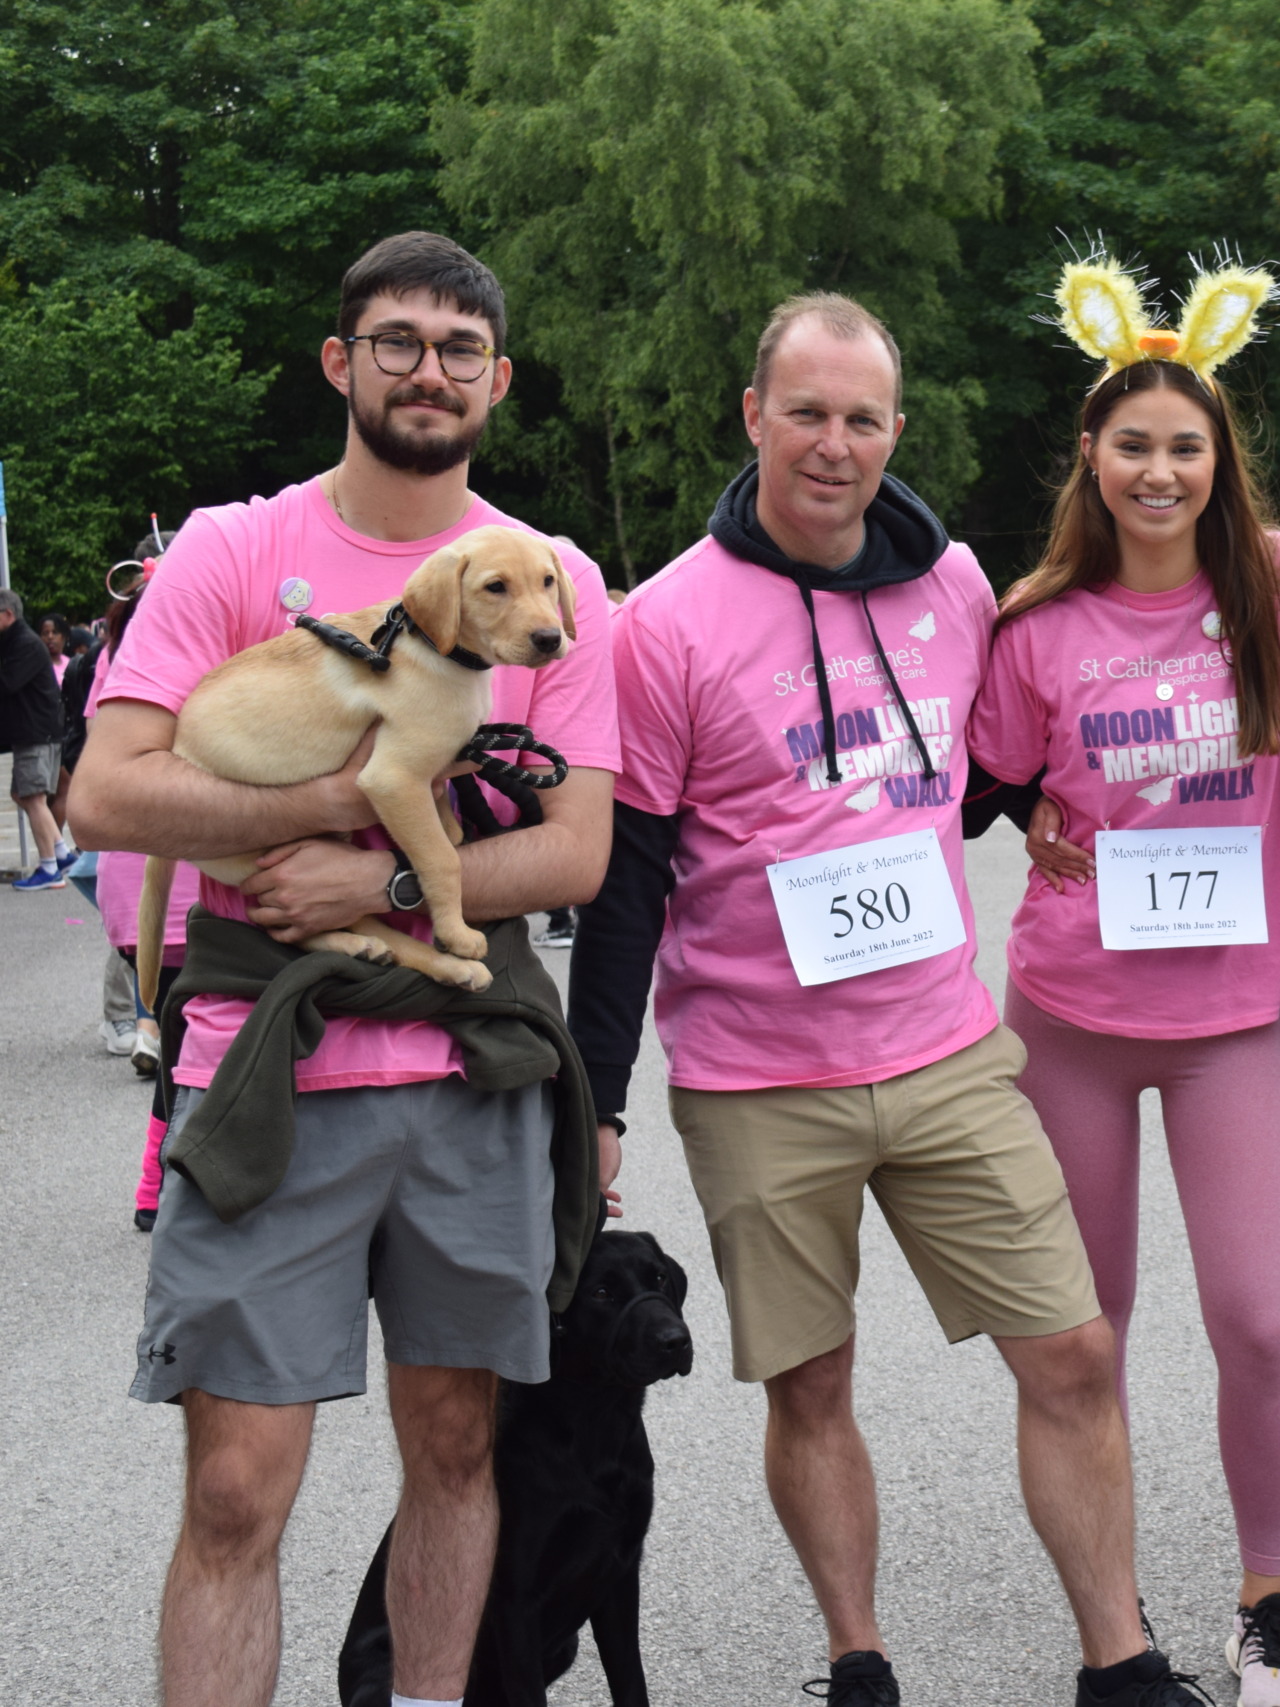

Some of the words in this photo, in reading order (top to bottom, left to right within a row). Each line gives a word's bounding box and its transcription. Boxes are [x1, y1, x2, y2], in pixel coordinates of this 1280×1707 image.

[773, 670, 798, 696] St
[901, 668, 928, 680] care
[1079, 658, 1102, 682] St
[1210, 667, 1231, 679] car
[1080, 697, 1240, 748] MOONLIGH
[795, 765, 805, 783] &
[1086, 751, 1101, 770] &
[1102, 735, 1255, 783] MEMORIE
[885, 771, 956, 808] WALK
[1178, 764, 1255, 804] WALK
[786, 866, 852, 891] Moonlight
[856, 862, 869, 874] &
[872, 849, 929, 870] Memories
[1109, 843, 1172, 863] Moonlight
[1175, 845, 1187, 856] &
[1192, 843, 1249, 856] Memories
[1145, 870, 1219, 911] 177
[830, 882, 911, 939] 580
[1130, 922, 1170, 933] Saturday
[1173, 921, 1191, 930] 18th
[1194, 921, 1214, 930] June
[1217, 920, 1237, 929] 2022
[823, 949, 866, 965] Saturday
[868, 942, 889, 954] 18th
[890, 938, 911, 949] June
[912, 930, 934, 943] 2022
